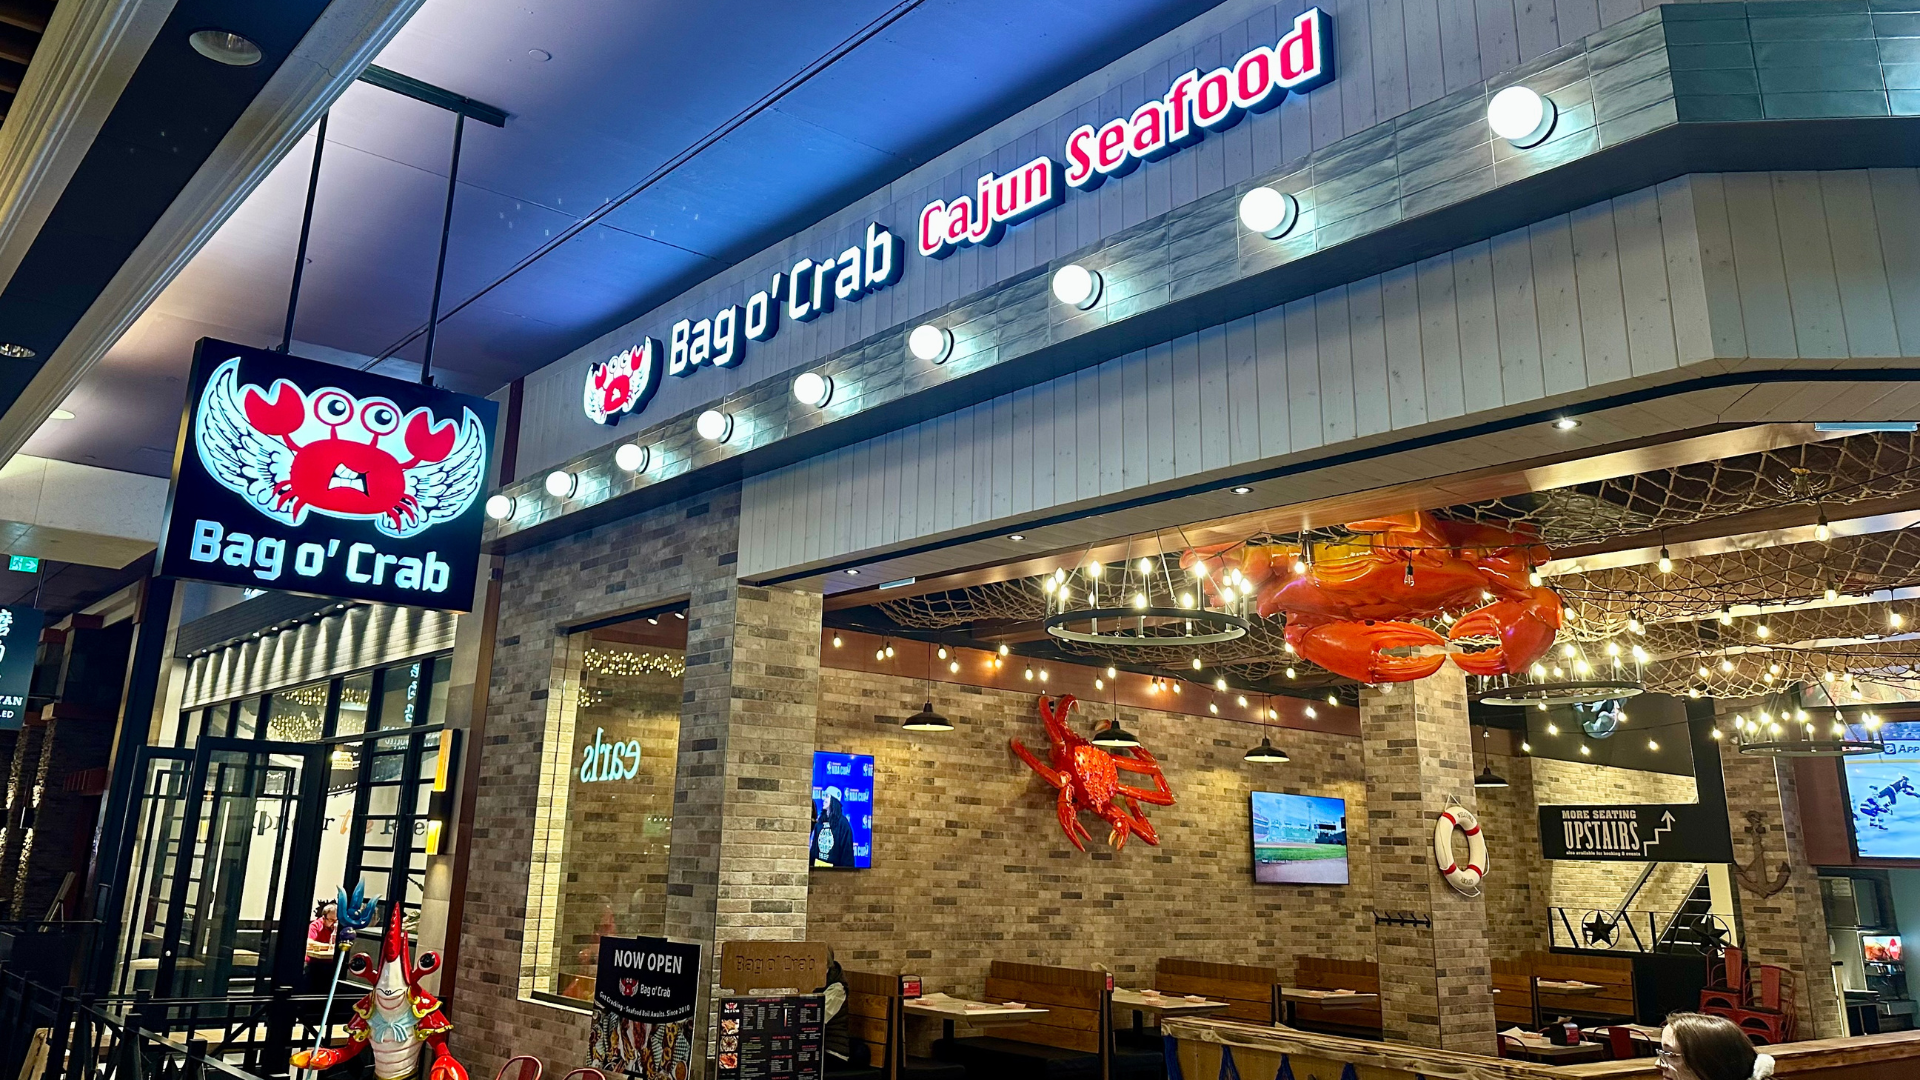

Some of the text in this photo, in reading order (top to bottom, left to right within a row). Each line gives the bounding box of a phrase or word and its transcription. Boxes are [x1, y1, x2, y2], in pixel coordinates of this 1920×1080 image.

[669, 308, 736, 377] Bag
[788, 223, 893, 320] Crab
[919, 156, 1054, 257] Cajun
[1065, 7, 1324, 188] Seafood
[190, 519, 451, 593] Bag o' Crab
[1562, 810, 1637, 819] MORE SEATING
[1563, 821, 1640, 850] UPSTAIRS
[614, 949, 682, 974] NOW OPEN
[735, 955, 763, 974] Bag
[783, 954, 816, 971] Crab
[640, 984, 651, 997] Bag
[658, 986, 671, 998] Crab
[626, 1006, 642, 1016] Seafood
